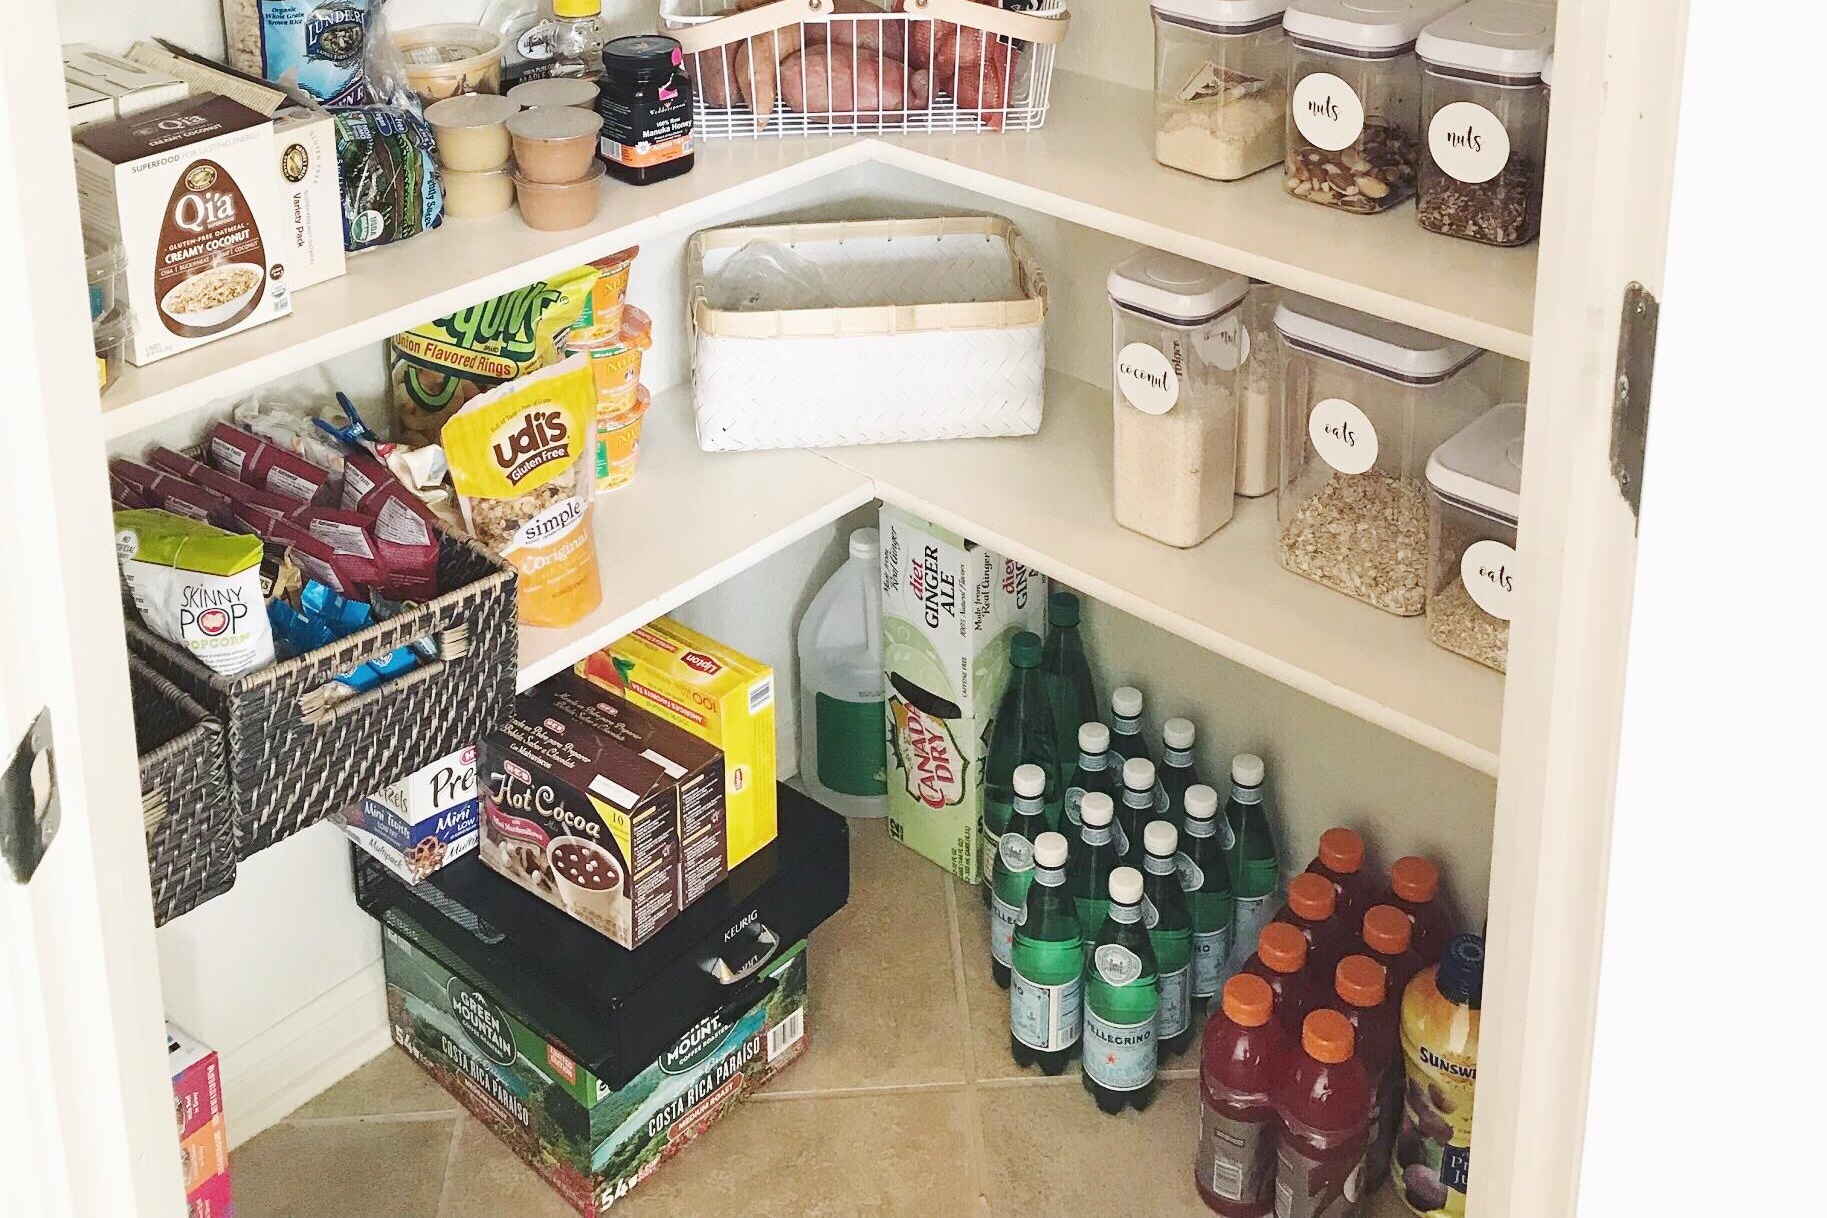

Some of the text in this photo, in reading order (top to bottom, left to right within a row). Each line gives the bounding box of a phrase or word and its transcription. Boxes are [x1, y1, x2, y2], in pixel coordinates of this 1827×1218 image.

[1308, 95, 1340, 122] nuts
[184, 123, 222, 138] COCONUT
[642, 120, 693, 138] Manuka Honey
[1446, 125, 1483, 152] nuts
[132, 154, 180, 173] SUPERFOOD
[293, 192, 304, 248] Variety Pack
[165, 229, 250, 264] CREAMY COCONUT
[169, 223, 245, 251] GLUTEN-FREE OATMEAL
[234, 240, 258, 253] COCONUT
[424, 342, 512, 378] Flavored Rings
[1119, 361, 1172, 392] coconut
[1324, 421, 1358, 447] oats
[511, 447, 566, 481] Gluten Free
[525, 501, 582, 539] simple
[909, 557, 924, 601] diet
[924, 545, 940, 629] GINGER
[940, 570, 955, 618] ALE
[982, 552, 993, 618] Real Ginger
[1479, 566, 1513, 593] oats
[180, 603, 248, 639] POP
[974, 607, 983, 631] Made
[685, 653, 717, 675] Lipton
[692, 692, 718, 714] 100
[925, 727, 955, 784] DRY
[364, 801, 384, 821] Mini
[435, 805, 471, 834] Mini
[490, 772, 601, 839] Hot Cocoa
[612, 812, 624, 826] 10
[457, 817, 476, 831] LOW
[723, 910, 758, 943] KEURIG
[453, 997, 512, 1057] MOUNTAIN
[460, 991, 501, 1033] GREEN
[394, 1024, 413, 1055] 54
[441, 1036, 470, 1072] COSTA
[470, 1060, 492, 1093] RICA
[648, 1036, 760, 1138] COSTA RICA PARAÍSO
[677, 1081, 734, 1131] MEDIUM ROAST
[601, 1177, 629, 1213] 54
